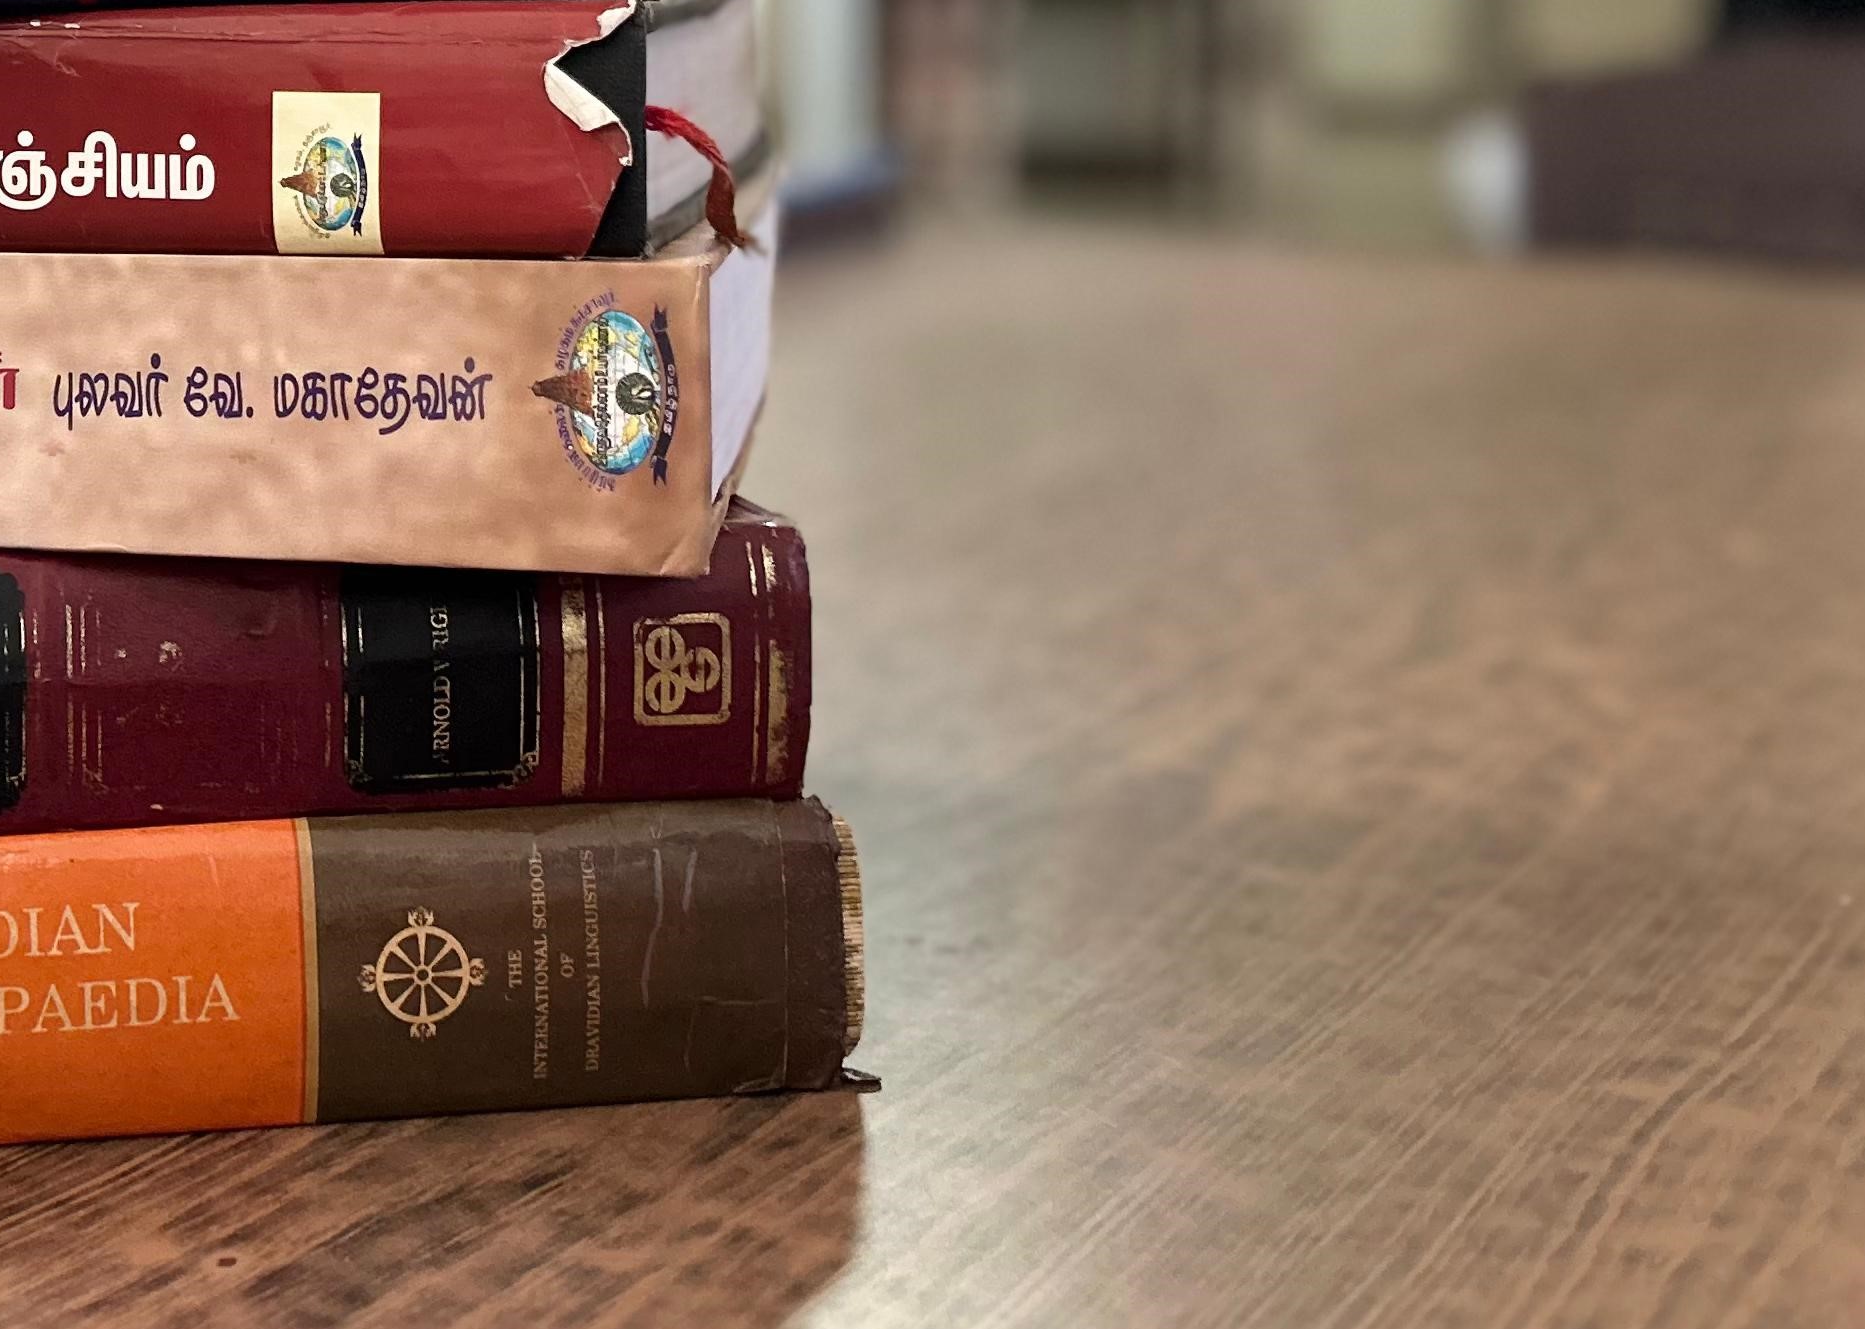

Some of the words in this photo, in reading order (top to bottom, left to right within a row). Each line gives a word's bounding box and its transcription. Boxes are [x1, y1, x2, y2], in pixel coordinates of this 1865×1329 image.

[52, 352, 169, 431] புலவர்
[273, 355, 494, 435] மகாதேவன்
[528, 848, 547, 930] SCHOOL
[579, 847, 601, 971] LINGUISTICS
[507, 948, 523, 989] THE
[531, 933, 550, 1080] INTERNATIONAL
[560, 951, 576, 979] OF
[583, 974, 601, 1073] DRAVIDIAN
